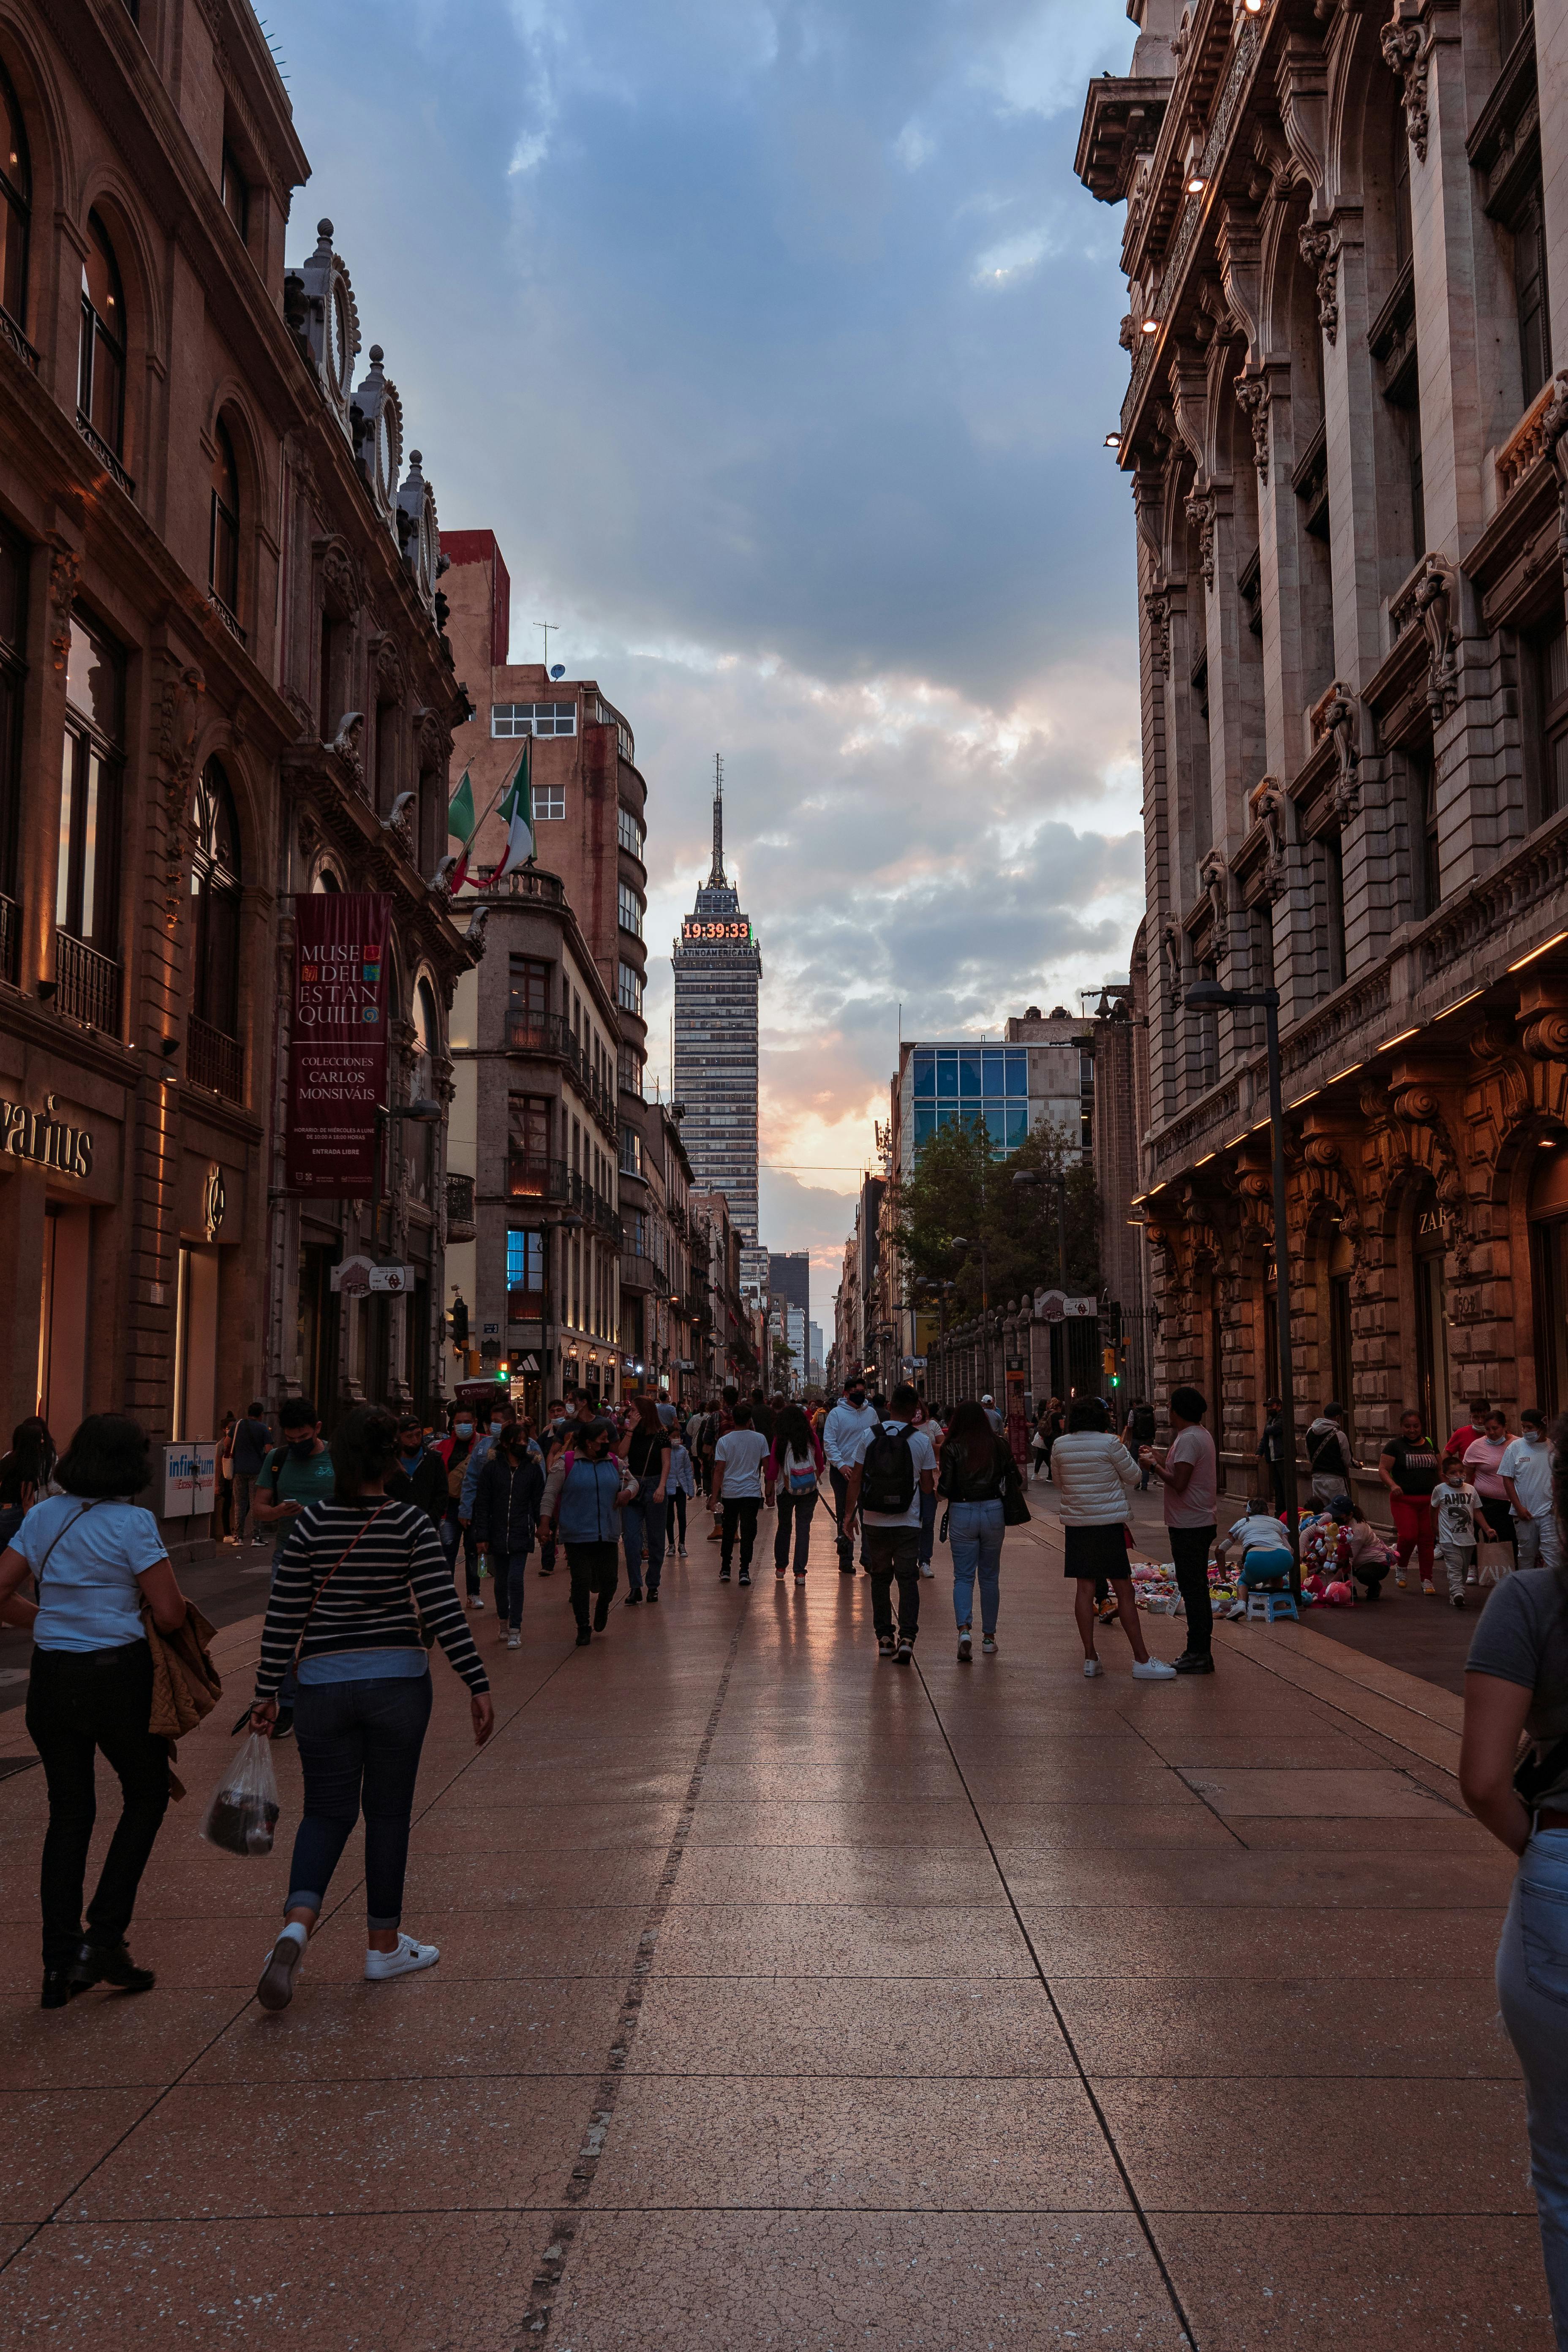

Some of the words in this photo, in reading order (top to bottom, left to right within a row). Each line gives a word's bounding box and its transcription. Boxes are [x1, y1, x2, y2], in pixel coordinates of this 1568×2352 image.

[684, 923, 748, 939] 19:39:33
[321, 966, 361, 982] DEL
[300, 986, 378, 1003] ESTAN
[302, 1057, 374, 1067] COLECCIONES
[309, 1072, 365, 1083] CARLOS
[299, 1086, 375, 1100] MONSIVÁIS
[1444, 1493, 1472, 1505] AHOY
